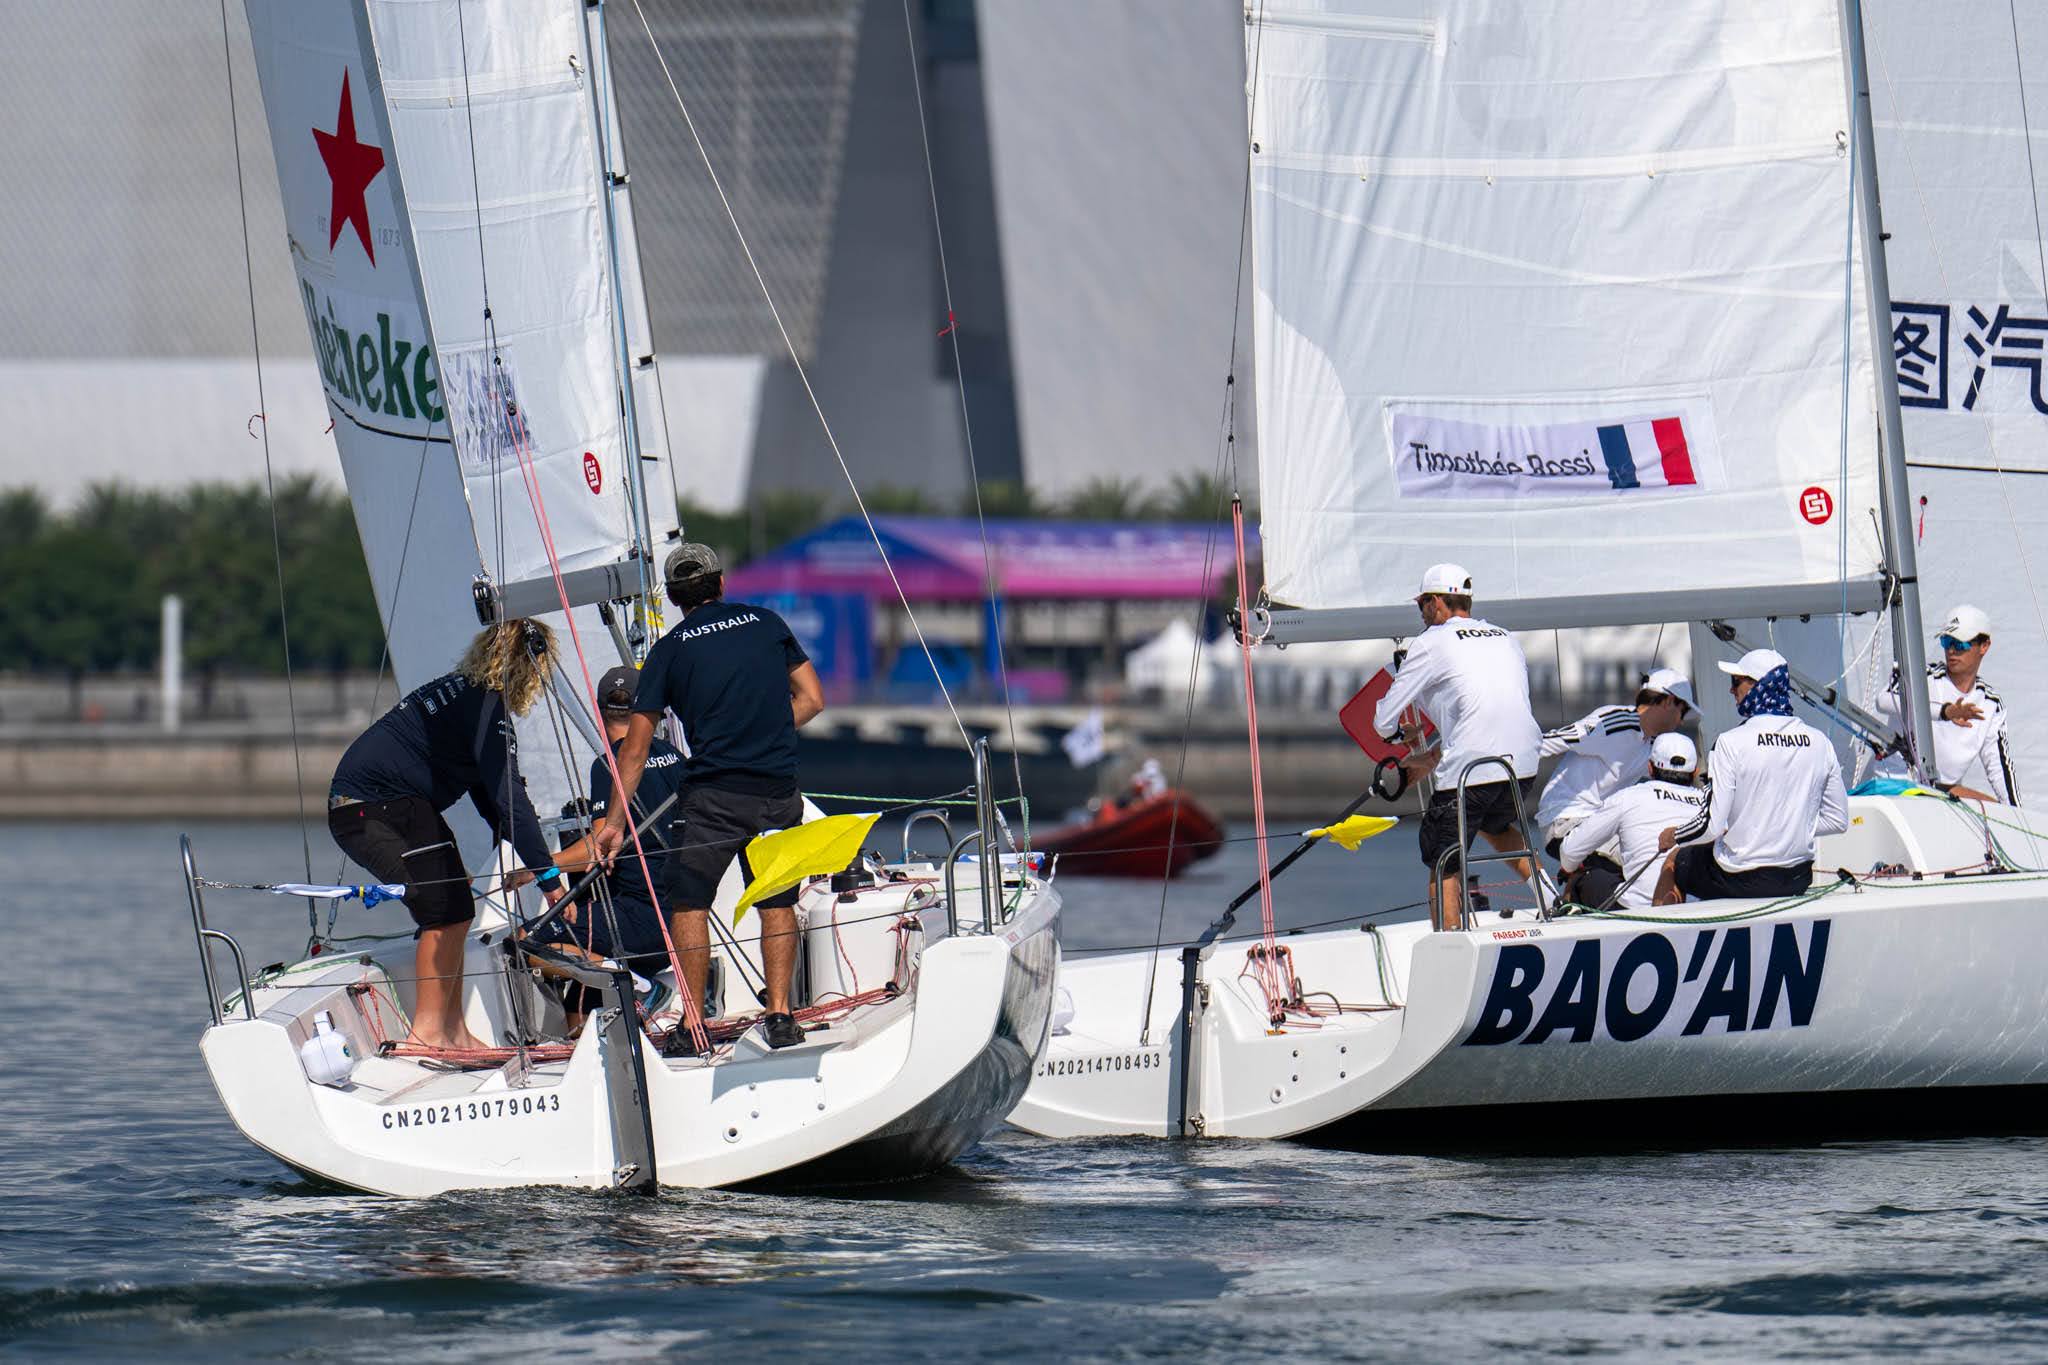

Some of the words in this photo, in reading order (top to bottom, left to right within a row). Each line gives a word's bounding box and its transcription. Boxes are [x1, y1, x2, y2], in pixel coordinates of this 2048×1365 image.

[1526, 449, 1596, 476] Rossi
[682, 613, 760, 641] AUSTRALIA
[1455, 629, 1507, 641] ROSSI
[1757, 732, 1811, 748] ARTHAUD
[1492, 929, 1527, 940] FAREAST
[1461, 918, 1832, 1047] BAO'AN
[382, 1094, 560, 1130] CN20213079043
